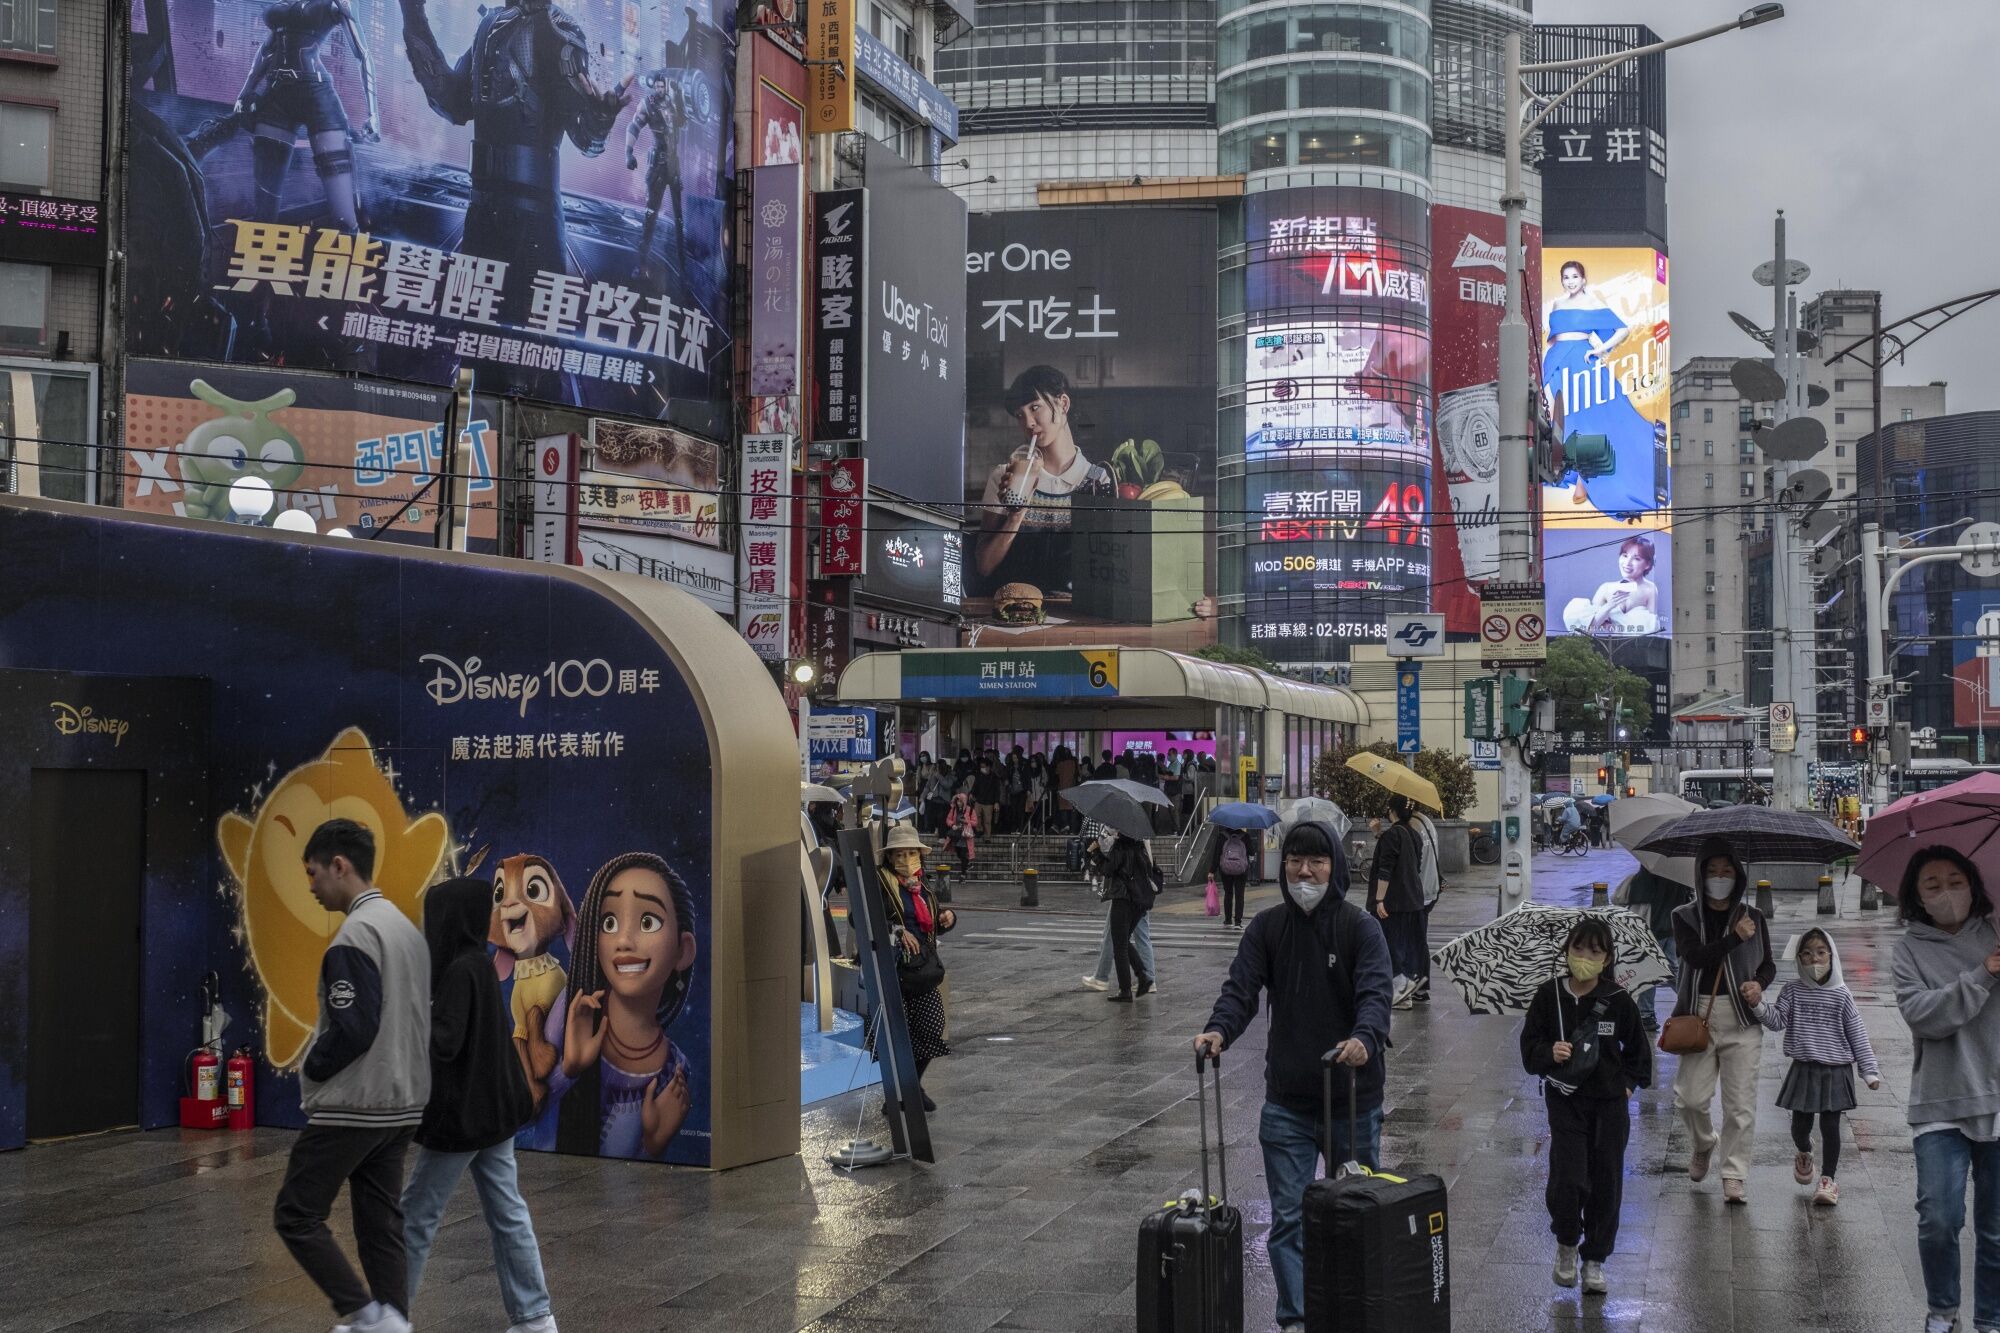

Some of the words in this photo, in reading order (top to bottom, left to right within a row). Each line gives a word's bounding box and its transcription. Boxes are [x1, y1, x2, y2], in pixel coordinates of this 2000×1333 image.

[828, 21, 839, 57] 西門館
[823, 109, 834, 118] 5F
[820, 234, 853, 245] AORUS
[1268, 216, 1377, 254] 新起點
[1001, 242, 1072, 273] One
[1459, 240, 1506, 264] Budwe
[213, 219, 510, 327] 異能覺醒
[764, 237, 783, 312] 湯の花
[822, 254, 853, 330] 駭客
[1459, 277, 1506, 307] 百威啤
[882, 280, 920, 332] Uber
[923, 303, 948, 347] Taxi
[981, 294, 1119, 342] 不吃土
[882, 330, 948, 381] 優步小黃
[829, 339, 844, 422] 網路電競館
[747, 440, 783, 454] 玉芙蓉
[848, 428, 858, 436] 4F
[621, 495, 635, 505] SPA
[638, 489, 670, 512] 按摩
[750, 469, 778, 520] 按摩
[1262, 489, 1361, 520] 壹新聞
[1365, 482, 1424, 545] 49
[749, 529, 777, 538] Massage
[686, 562, 721, 591] Salon
[749, 542, 777, 593] 護膚
[849, 563, 860, 571] 3F
[1255, 561, 1282, 572] MOD
[1351, 557, 1405, 572] 手機APP
[747, 614, 779, 639] 699
[419, 653, 540, 717] Disney
[544, 658, 612, 699] 100
[617, 667, 660, 695] 周年
[980, 661, 1036, 679] 西門站
[1005, 681, 1037, 689] STATION
[1089, 660, 1108, 688] 6
[50, 702, 130, 748] Disney
[451, 731, 625, 762] 魔法起源代表新作
[1329, 953, 1336, 967] P
[1430, 1236, 1440, 1304] GEOGRAPHIC
[1435, 1235, 1445, 1286] NATIONAL
